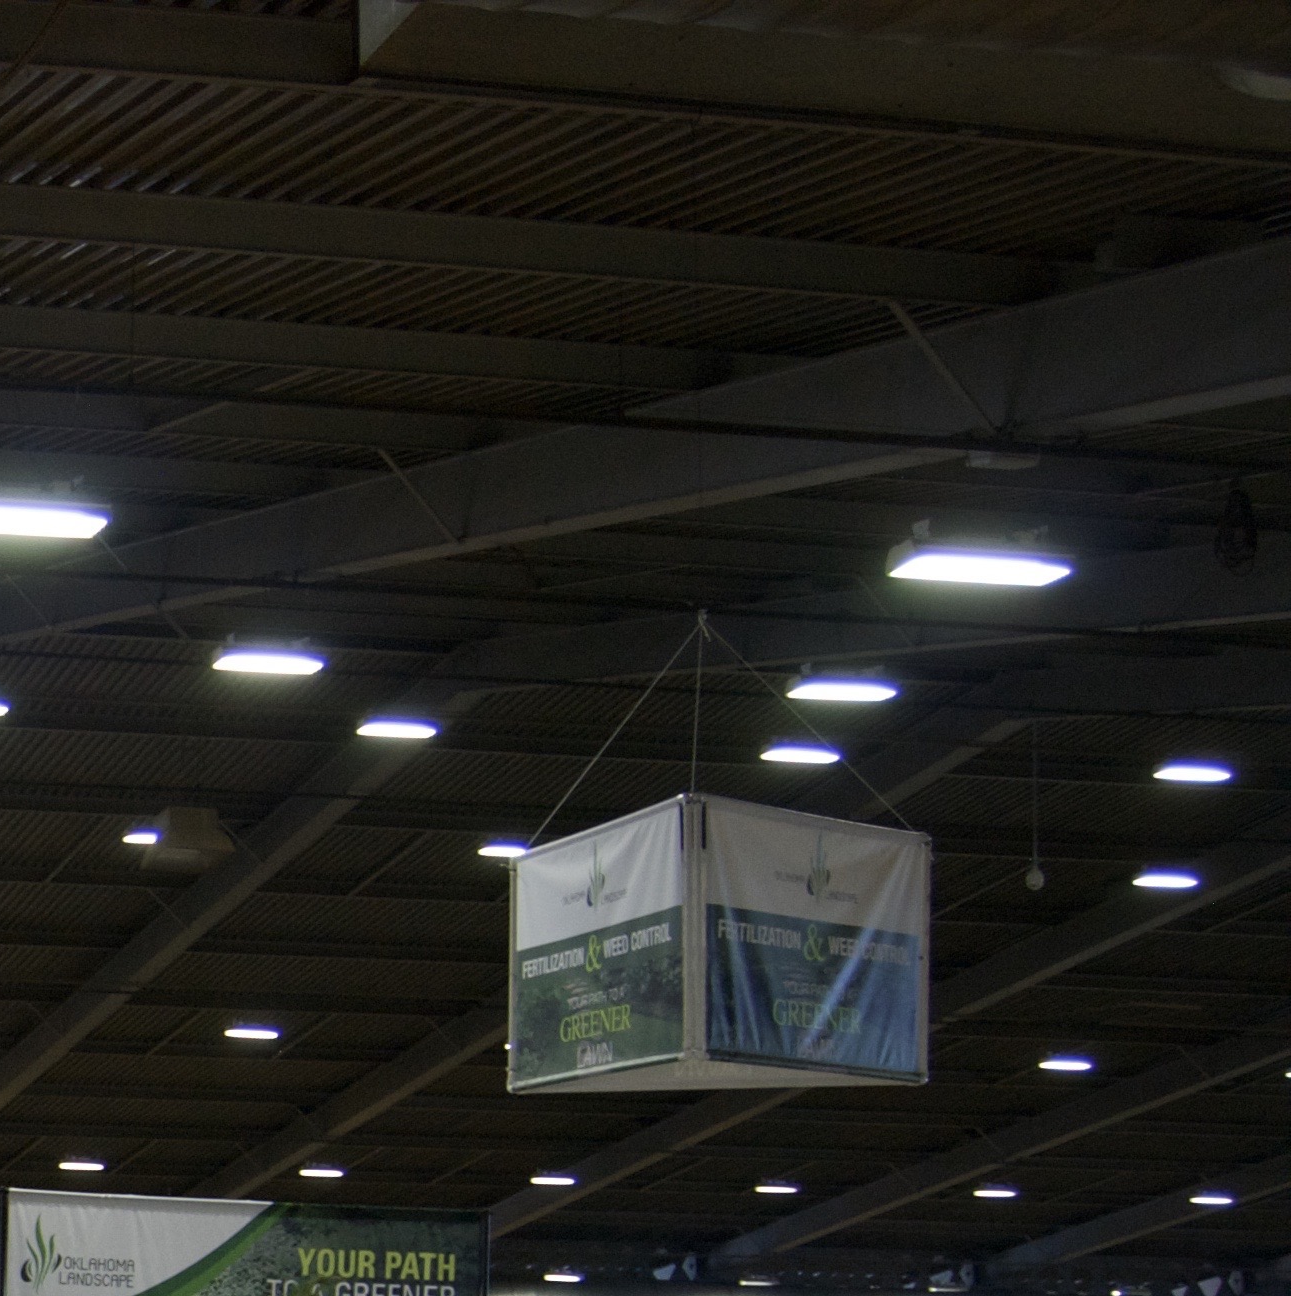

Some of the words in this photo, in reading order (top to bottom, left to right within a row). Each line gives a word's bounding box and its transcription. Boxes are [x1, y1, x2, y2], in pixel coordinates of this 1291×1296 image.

[522, 947, 585, 979] FERTILIZATION
[585, 935, 602, 972] &
[603, 934, 629, 959] WEED
[630, 922, 672, 951] CONTROL
[718, 919, 802, 951] FERTILIZATION
[803, 924, 824, 962] &
[560, 1004, 631, 1043] GREENER
[59, 1271, 134, 1288] LANDSCAPE
[64, 1256, 135, 1273] OKLAHOMA
[297, 1247, 376, 1279] YOUR
[384, 1250, 456, 1282] PATH
